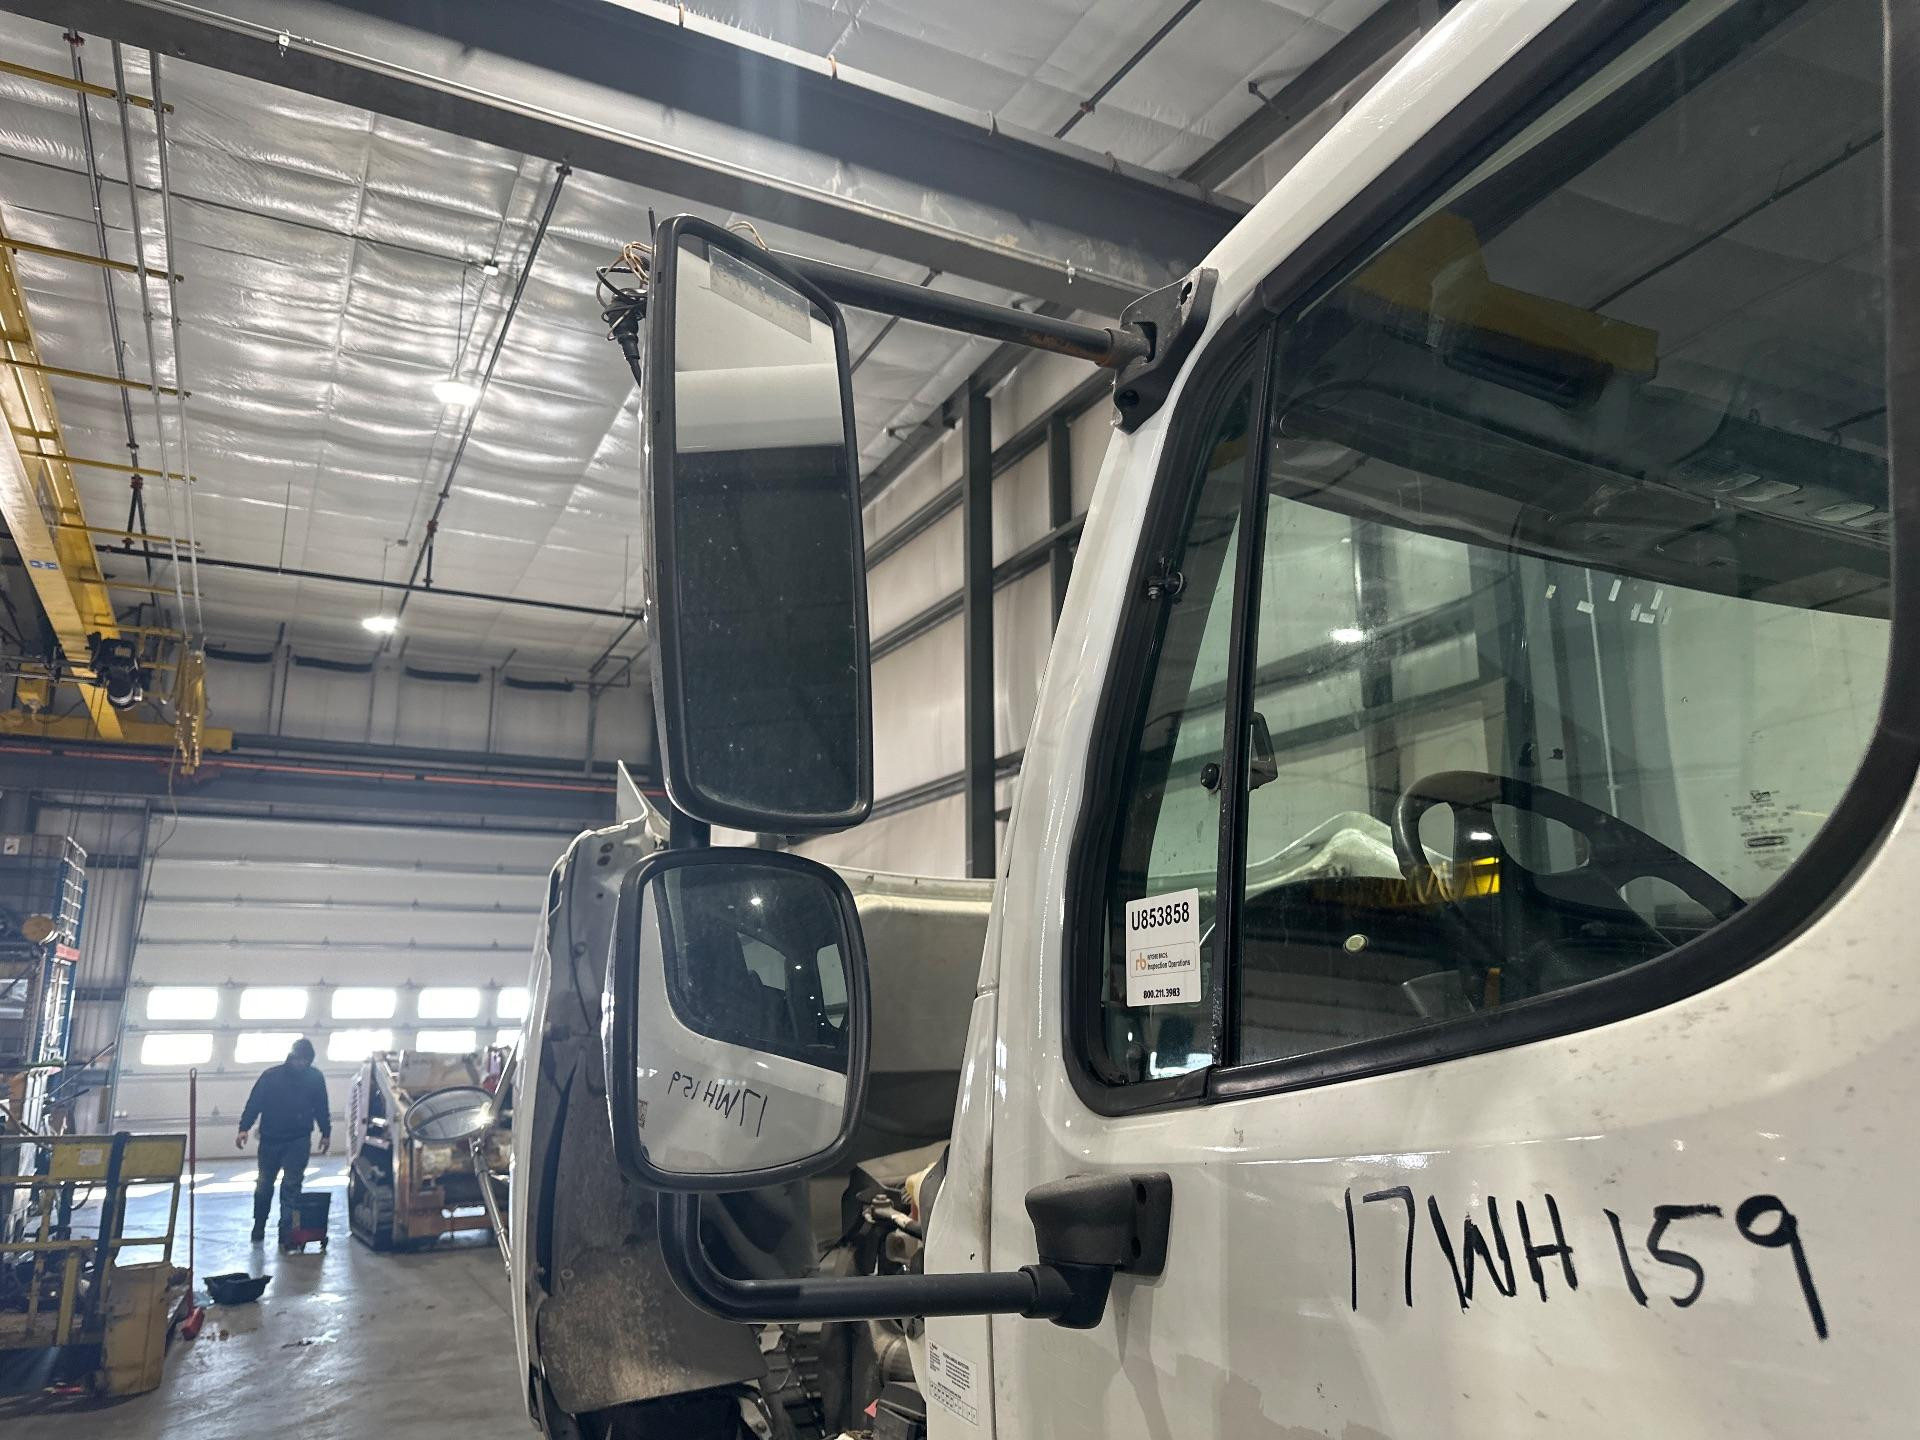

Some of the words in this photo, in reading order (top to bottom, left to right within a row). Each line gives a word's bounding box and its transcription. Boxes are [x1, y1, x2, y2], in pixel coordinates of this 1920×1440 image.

[1131, 902, 1189, 930] U853858
[1147, 961, 1168, 971] Inspection
[1168, 958, 1191, 969] Operations
[1143, 987, 1180, 999] 800.211.3983
